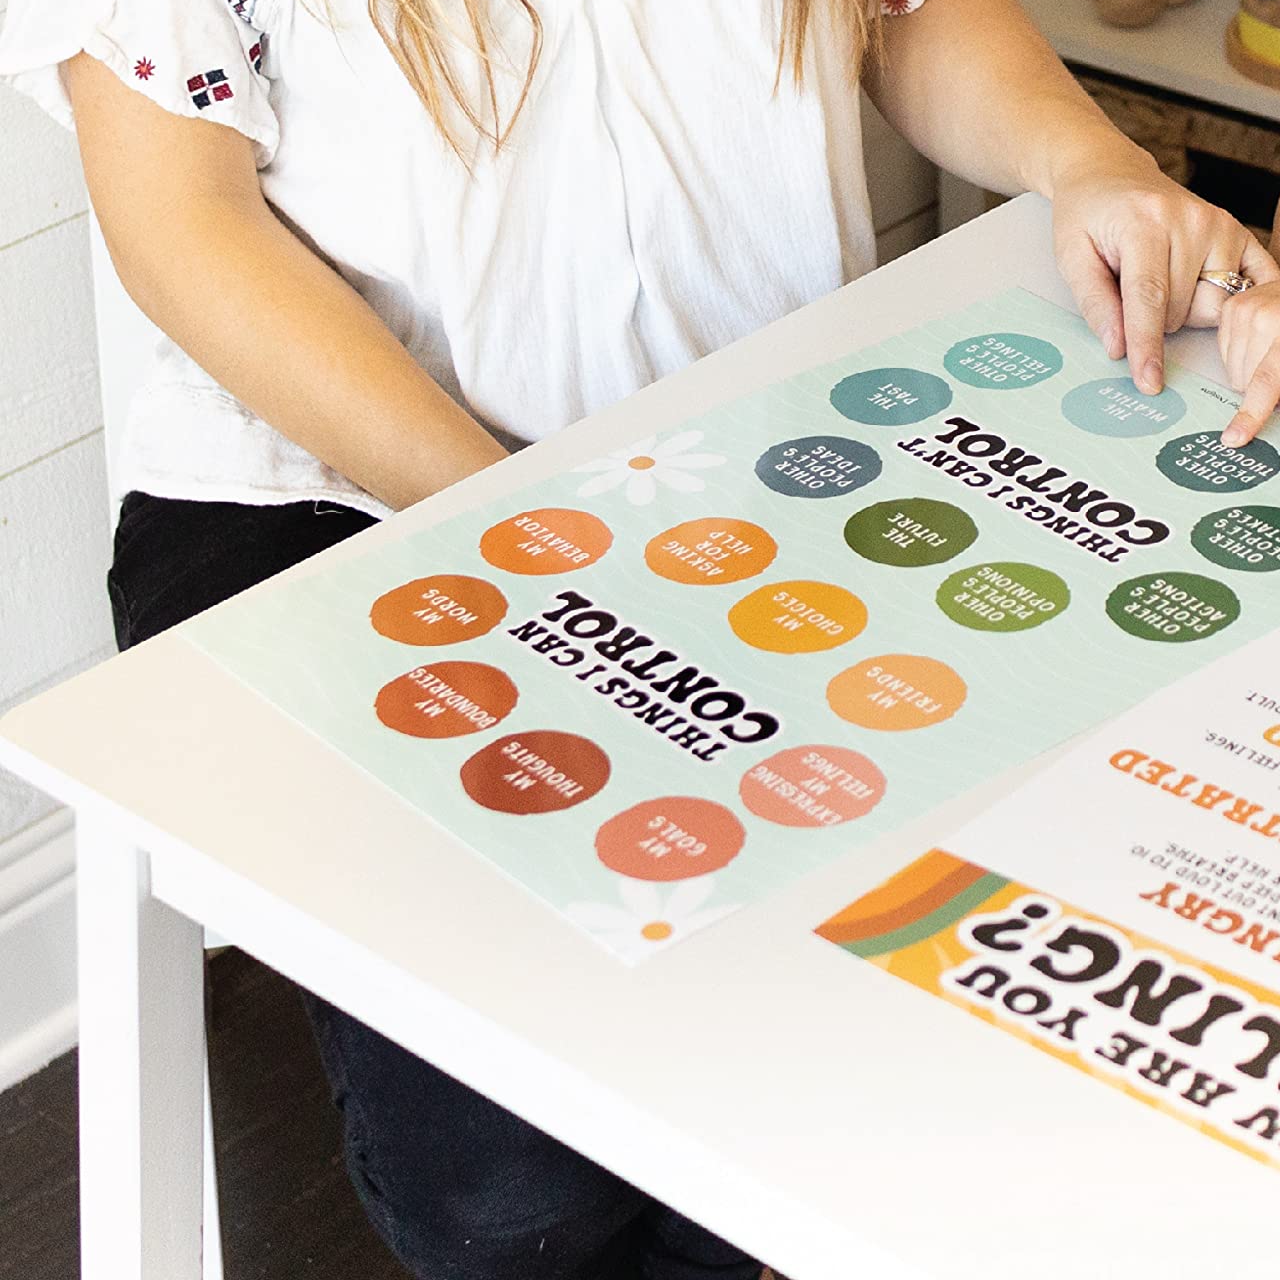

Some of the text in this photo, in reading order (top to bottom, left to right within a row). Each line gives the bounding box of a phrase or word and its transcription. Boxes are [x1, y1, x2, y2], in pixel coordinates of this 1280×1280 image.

[957, 355, 1010, 384] OTHER
[981, 336, 1053, 375] FEELINGS
[865, 391, 899, 412] THE
[876, 381, 921, 407] PAST
[1096, 385, 1170, 424] WEATHER
[1100, 402, 1134, 422] THE
[773, 459, 827, 490] OTHER
[781, 446, 855, 489] PEOPLE'S
[809, 444, 863, 475] IDEAS
[1174, 455, 1229, 486] OTHER
[1179, 442, 1258, 485] PEOPLE'S
[1193, 433, 1275, 478] THOUGHTS
[895, 436, 1131, 564] THINGS I CAN'T
[933, 415, 1171, 554] CONTROL
[513, 515, 591, 565] BEHAVIOR
[516, 539, 548, 558] MY
[706, 529, 754, 556] HELP
[881, 526, 916, 550] THE
[886, 511, 949, 549] FUTURE
[1207, 531, 1265, 565] OTHER
[660, 539, 725, 578] ASKING
[693, 539, 731, 562] FOR
[420, 587, 479, 626] WORDS
[952, 590, 1007, 623] OTHER
[960, 575, 1036, 622] PEOPLE'S
[975, 565, 1057, 613] OPINIONS
[1148, 577, 1228, 623] ACTIONS
[412, 606, 445, 626] MY
[771, 590, 846, 637] CHOICES
[772, 613, 805, 632] MY
[1122, 600, 1182, 636] OTHER
[1128, 585, 1212, 634] PEOPLE'S
[540, 589, 781, 745] CONTROL
[407, 666, 499, 731] BOUNDARIES
[413, 697, 448, 719] MY
[506, 619, 729, 763] THINGS I CAN
[865, 665, 943, 715] FRIENDS
[866, 689, 900, 710] MY
[501, 740, 585, 799] THOUGHTS
[502, 769, 538, 792] MY
[799, 776, 832, 797] MY
[800, 750, 876, 801] FEELINGS
[748, 764, 844, 830] EXPRESSING
[638, 836, 673, 859] MY
[646, 814, 709, 858] GOALS
[954, 964, 1090, 1042] YOU
[1093, 1030, 1238, 1109] ARE
